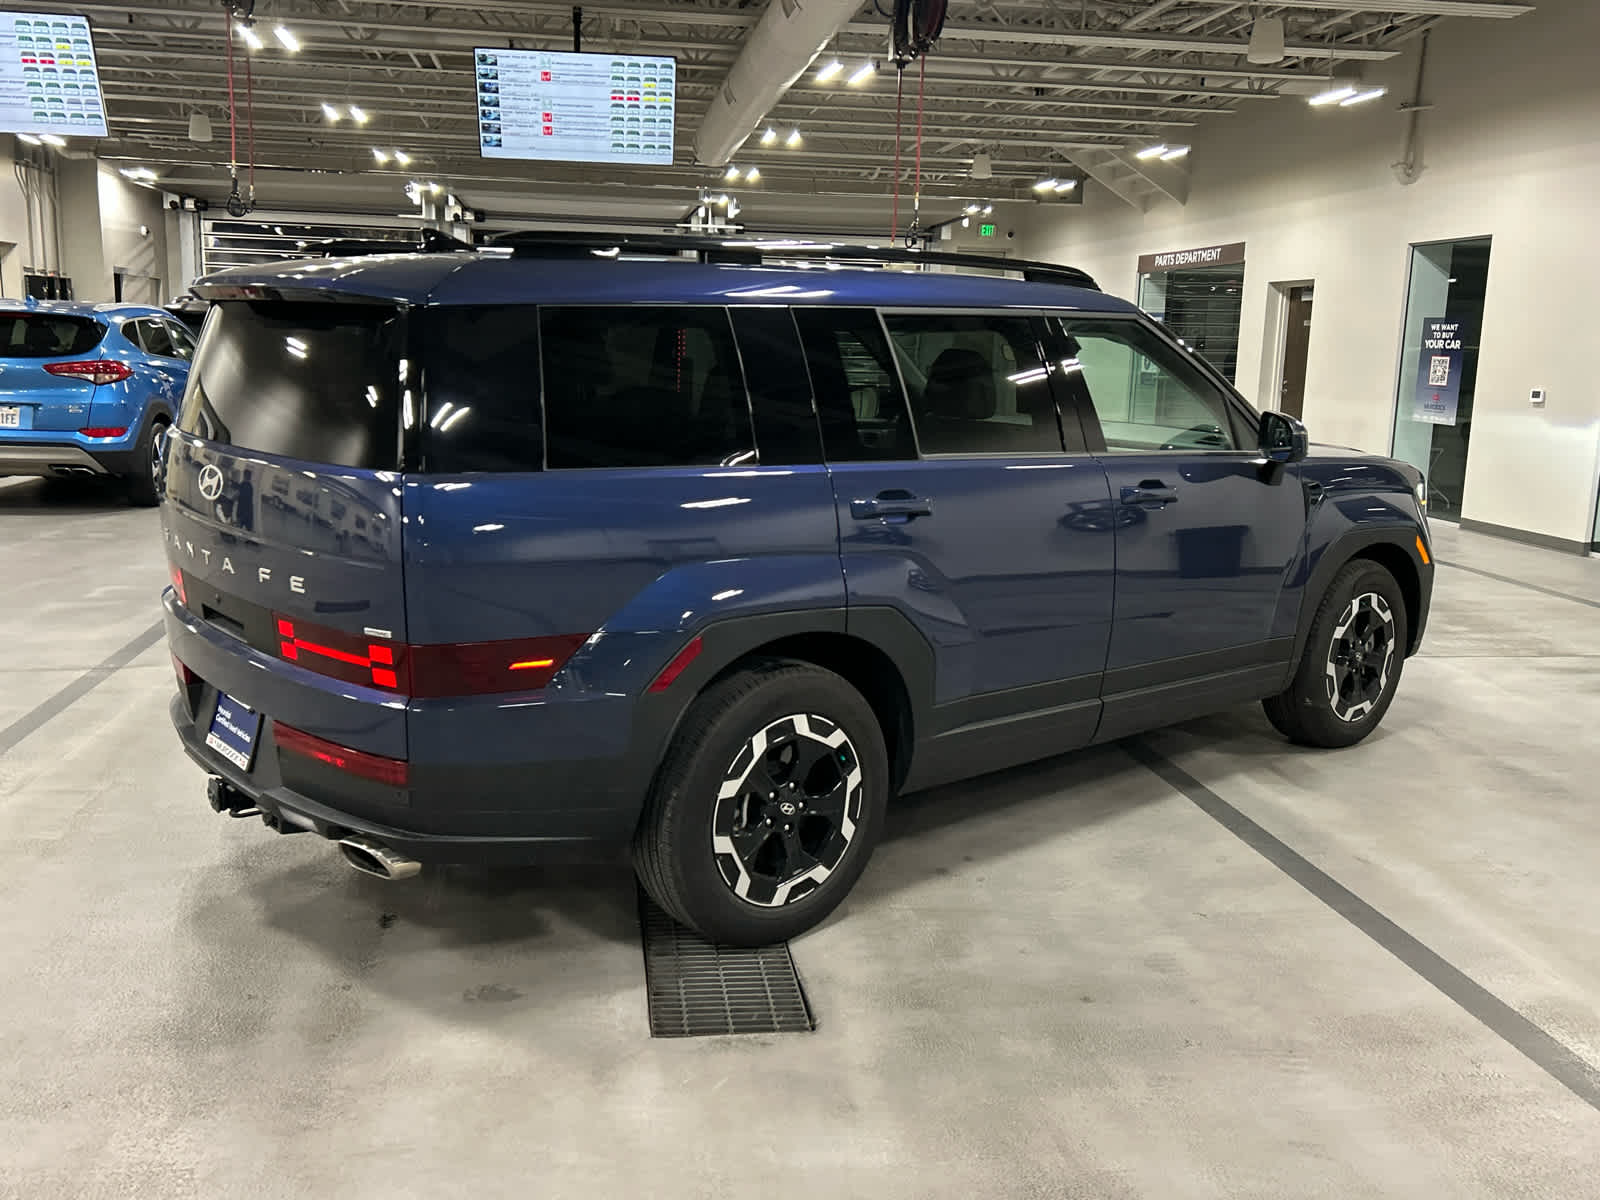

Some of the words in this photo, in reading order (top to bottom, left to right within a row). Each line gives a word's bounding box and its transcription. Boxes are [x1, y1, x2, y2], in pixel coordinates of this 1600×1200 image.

[1154, 254, 1175, 267] PARTS
[1175, 248, 1222, 265] DEPARTMENT
[1431, 323, 1440, 331] WE
[1441, 323, 1459, 331] WANT
[1441, 331, 1454, 339] BUY
[1424, 339, 1444, 349] YOUR
[1445, 339, 1461, 350] CAR
[257, 567, 305, 594] FE
